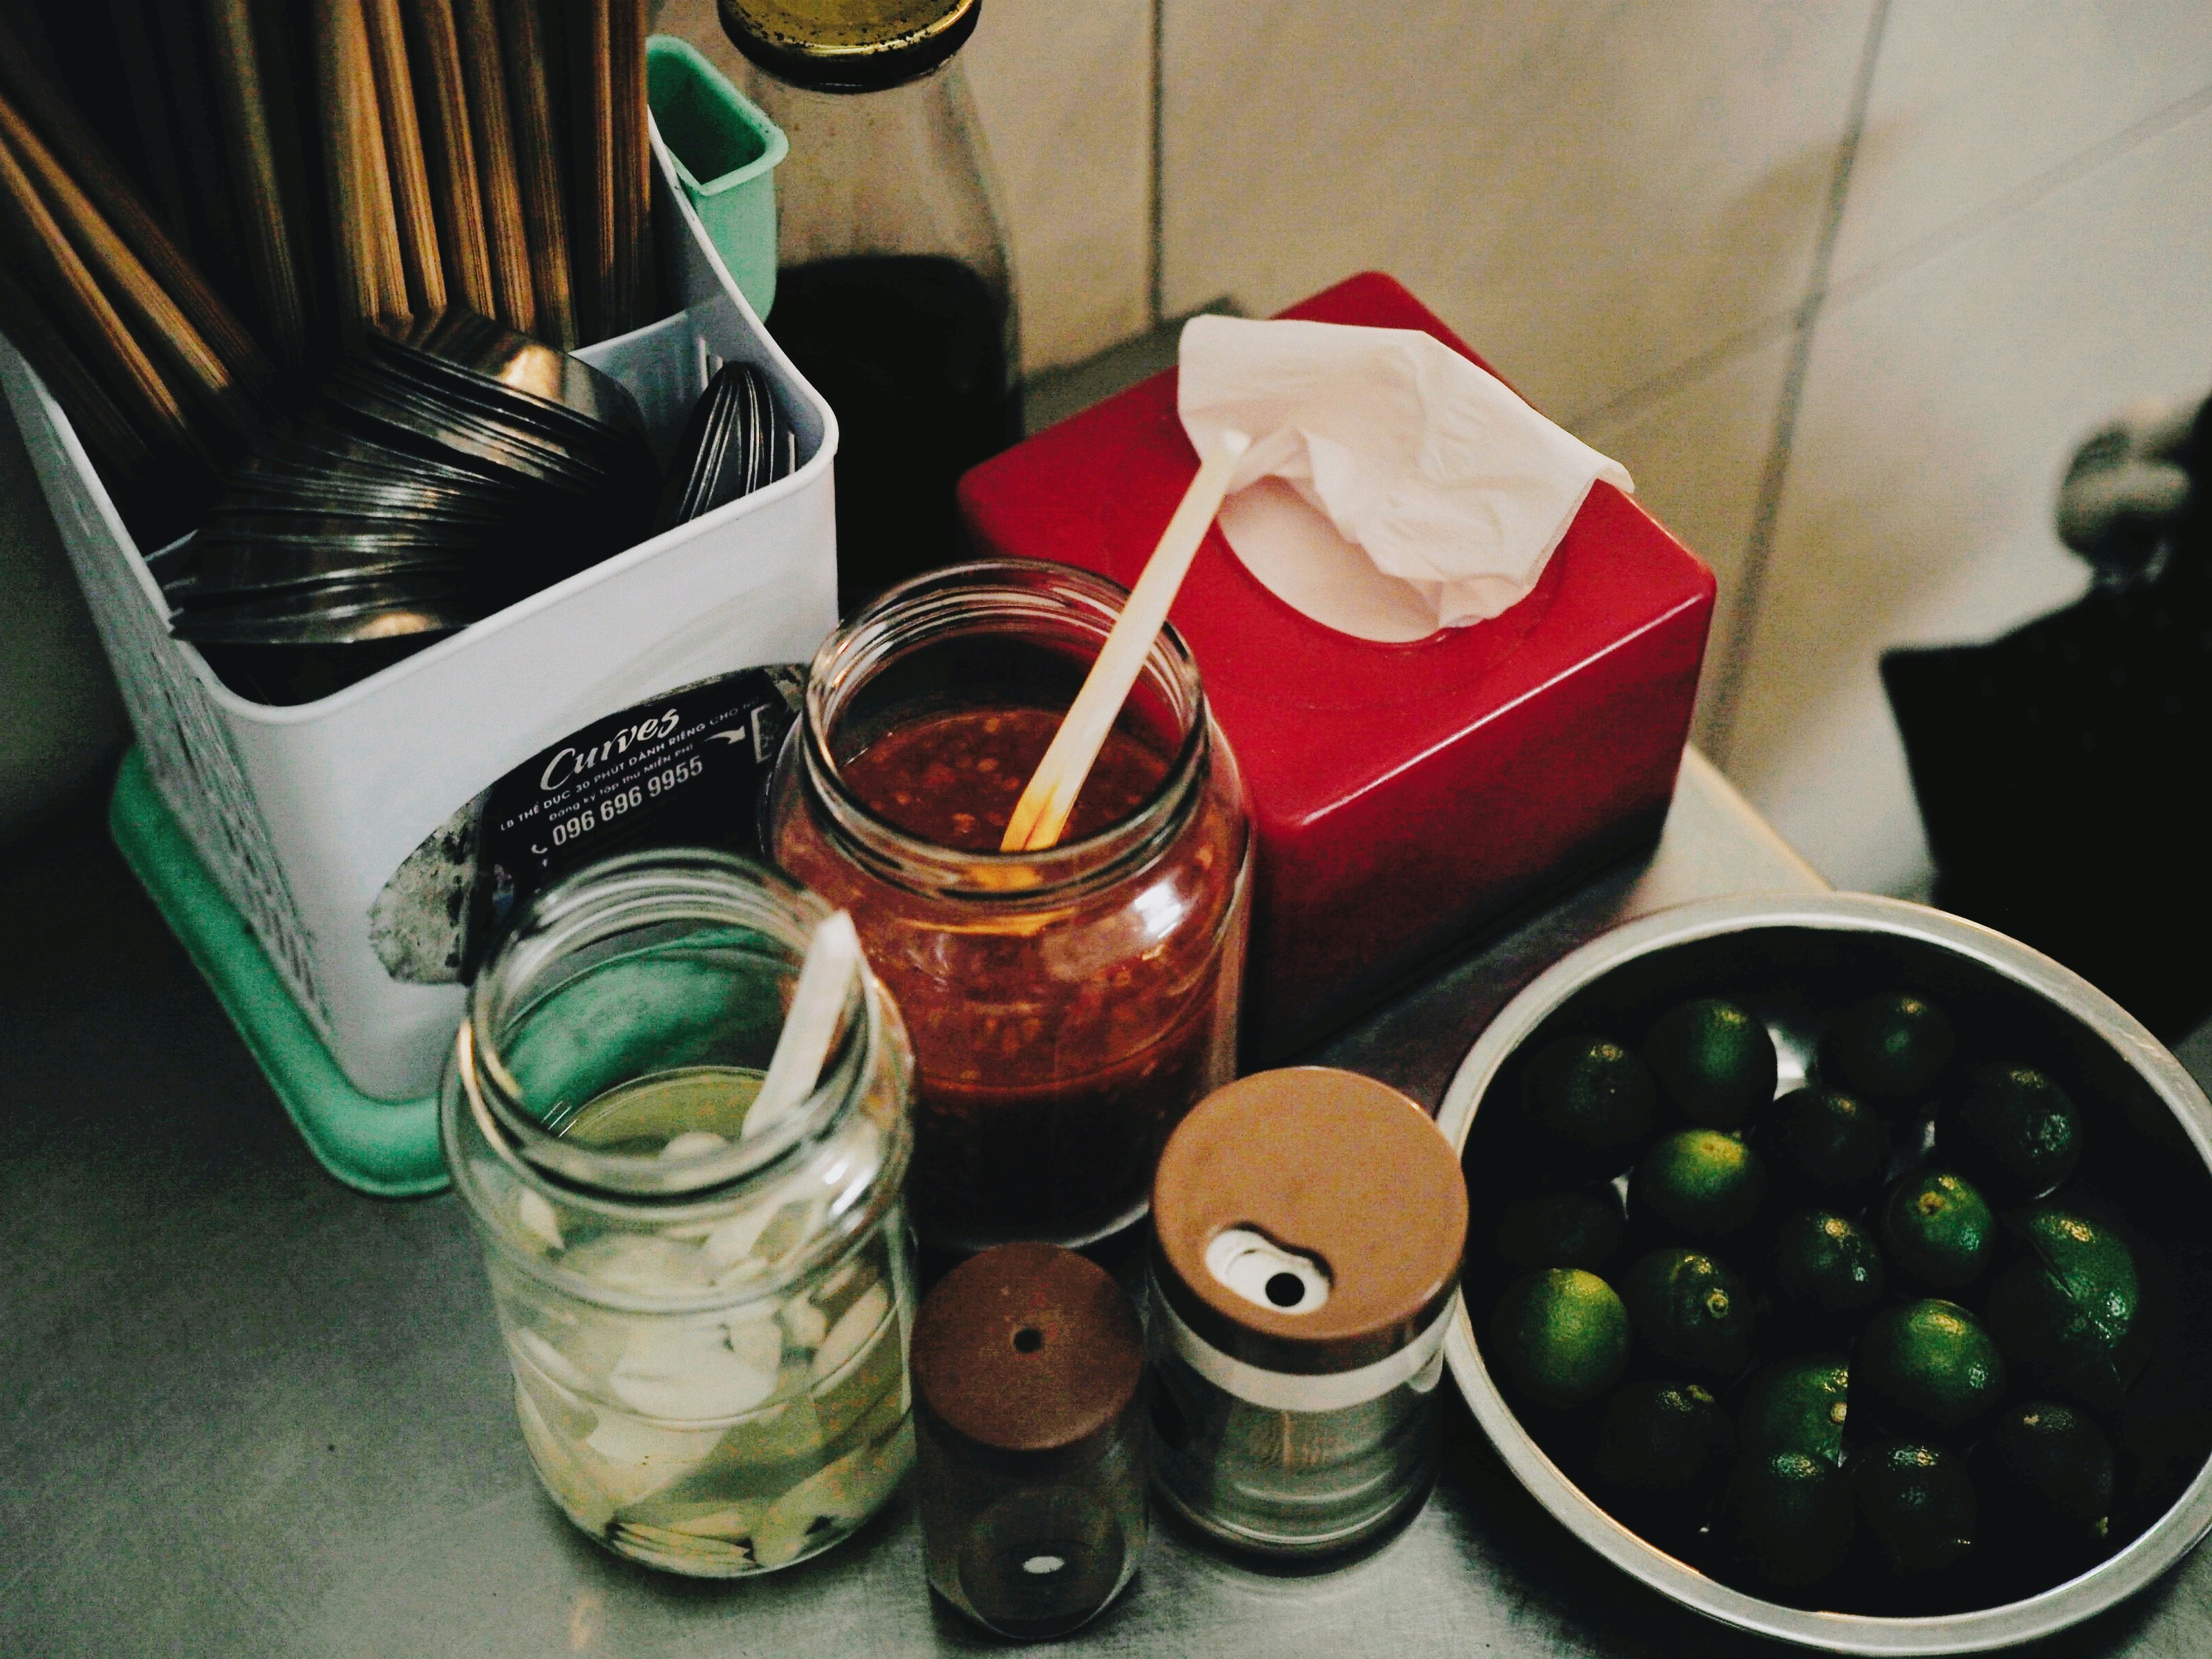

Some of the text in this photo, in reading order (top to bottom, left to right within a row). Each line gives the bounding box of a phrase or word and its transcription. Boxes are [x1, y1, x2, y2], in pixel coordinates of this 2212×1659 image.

[541, 708, 679, 791] Curves
[576, 780, 590, 793] 30
[668, 723, 706, 746] RIÊNG
[709, 707, 739, 726] CHO
[552, 754, 703, 846] 096 696 9955
